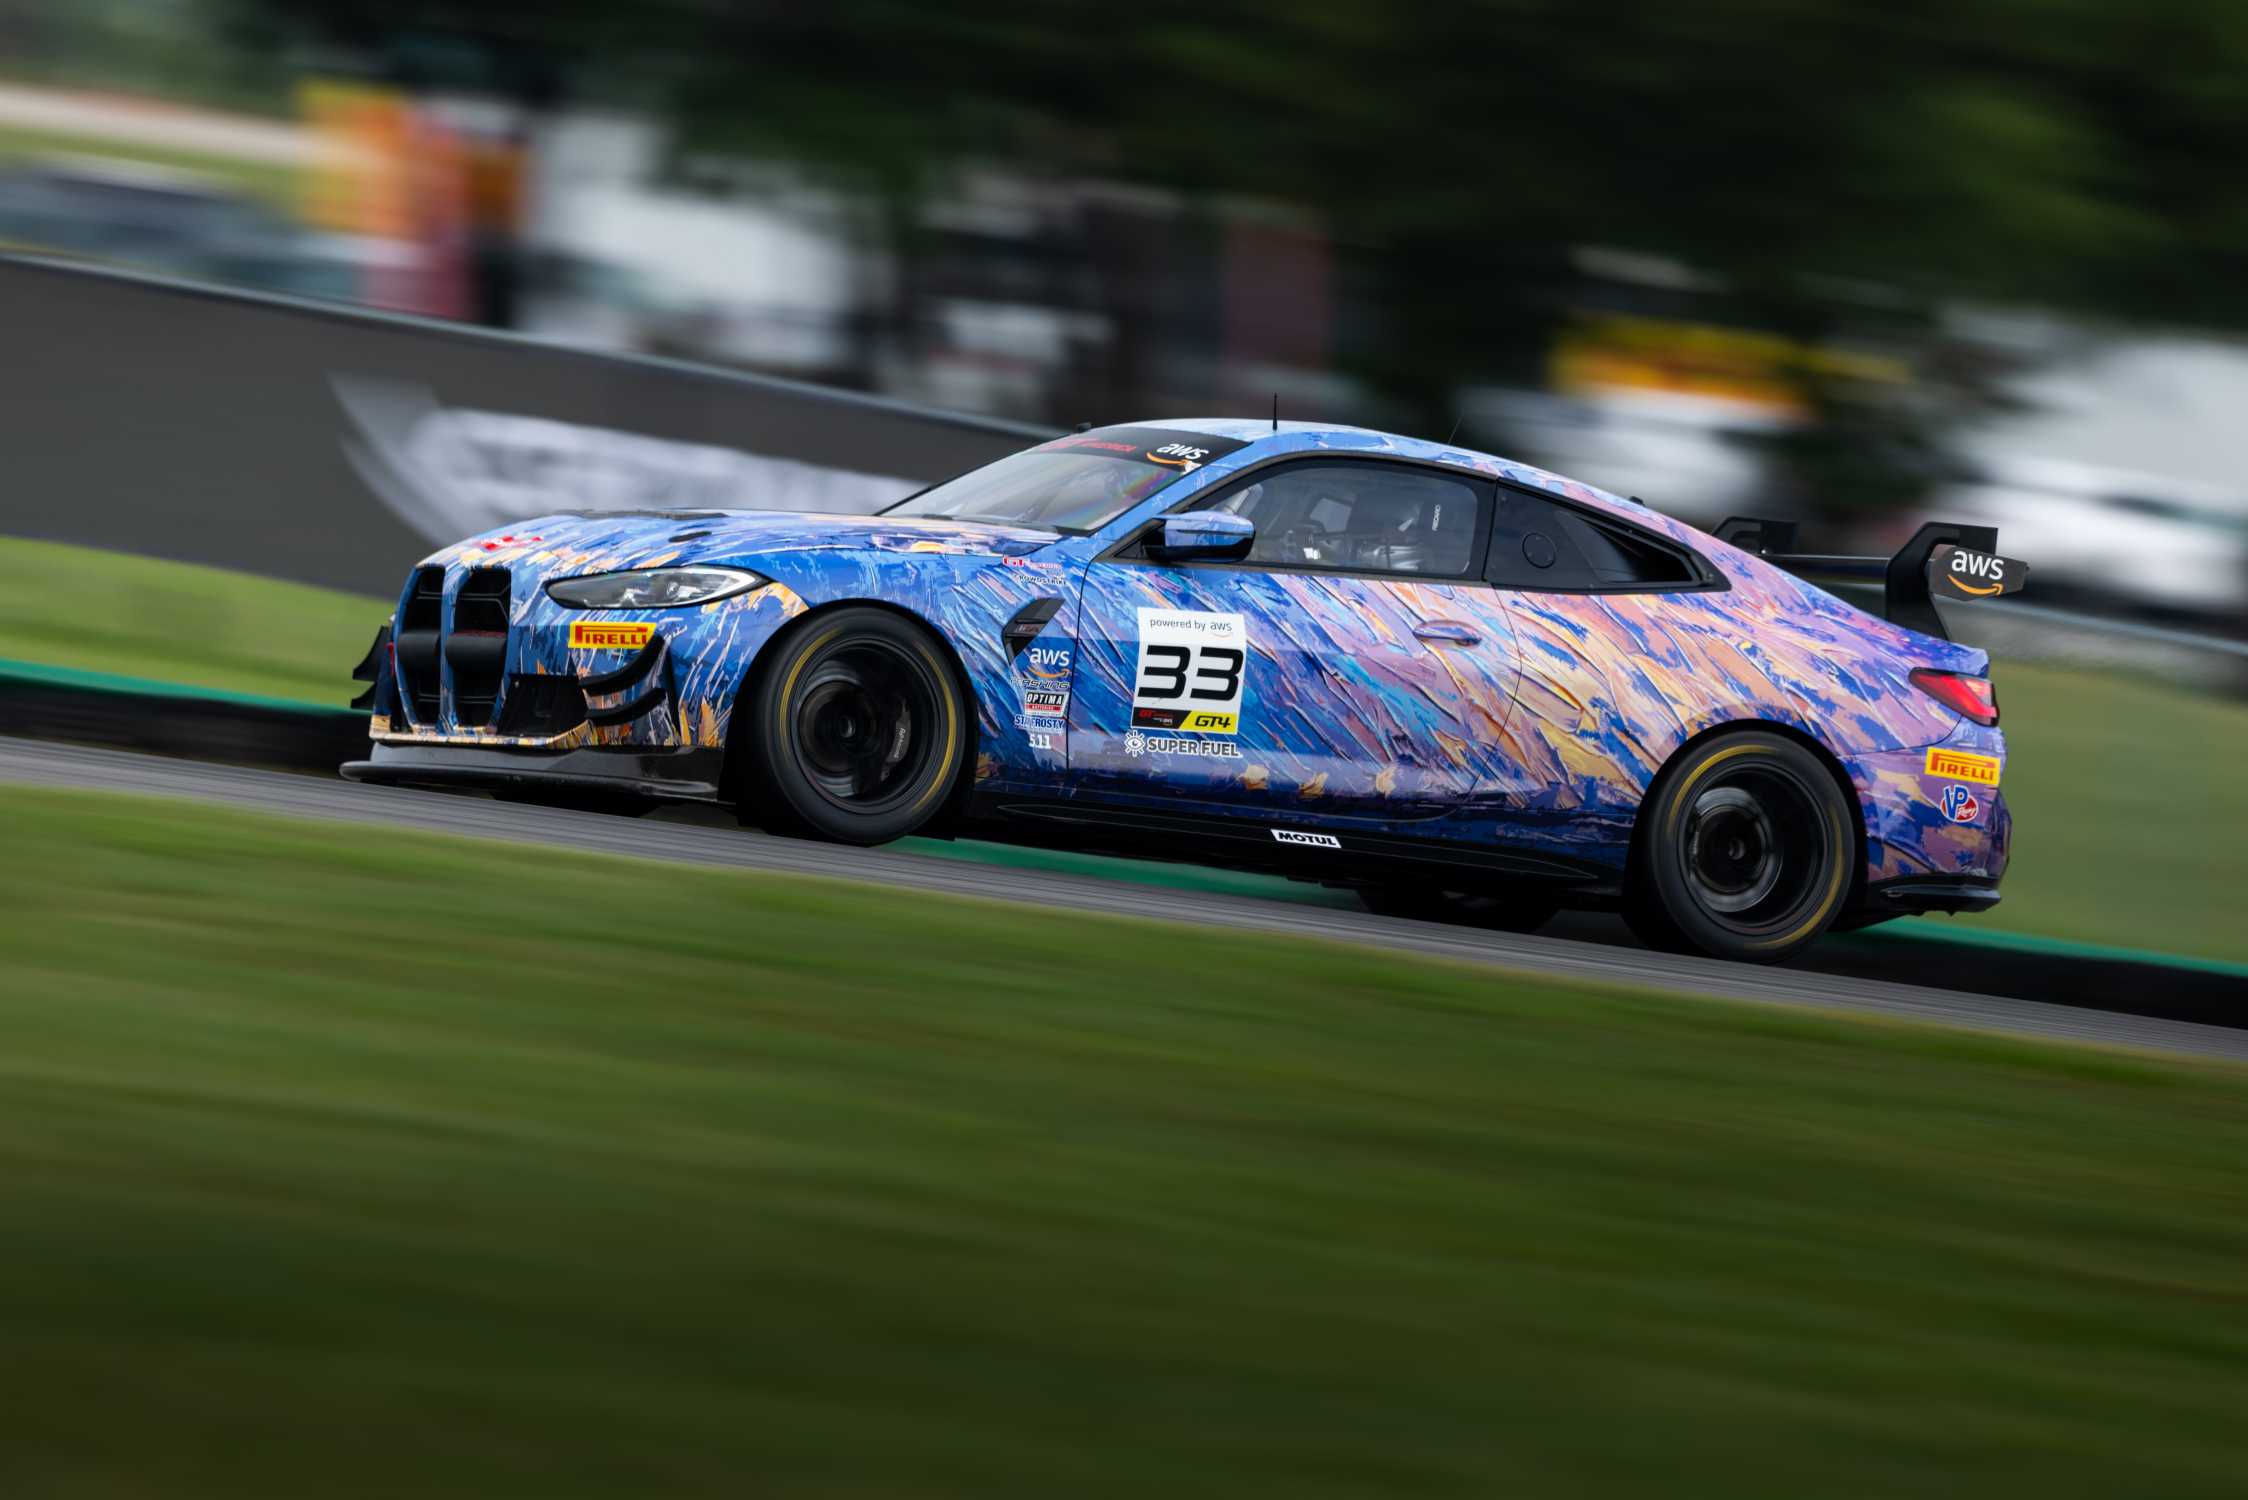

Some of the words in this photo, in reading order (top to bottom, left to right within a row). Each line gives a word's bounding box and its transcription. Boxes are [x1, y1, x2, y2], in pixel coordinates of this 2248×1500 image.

[1156, 443, 1210, 460] aws
[1951, 550, 2005, 580] aws
[574, 625, 648, 645] PIRELLI
[1150, 618, 1192, 630] powered
[1194, 621, 1206, 632] by
[1210, 621, 1233, 632] aws
[1029, 647, 1070, 667] aws
[1137, 644, 1244, 701] 33
[1026, 693, 1062, 705] OPTIMA
[1194, 715, 1231, 728] GT4
[1148, 737, 1198, 755] SUPER
[1201, 741, 1239, 757] FUEL
[1930, 752, 1996, 781] PIRELLI
[1944, 785, 1969, 819] VP
[1277, 831, 1337, 846] MOTUL
